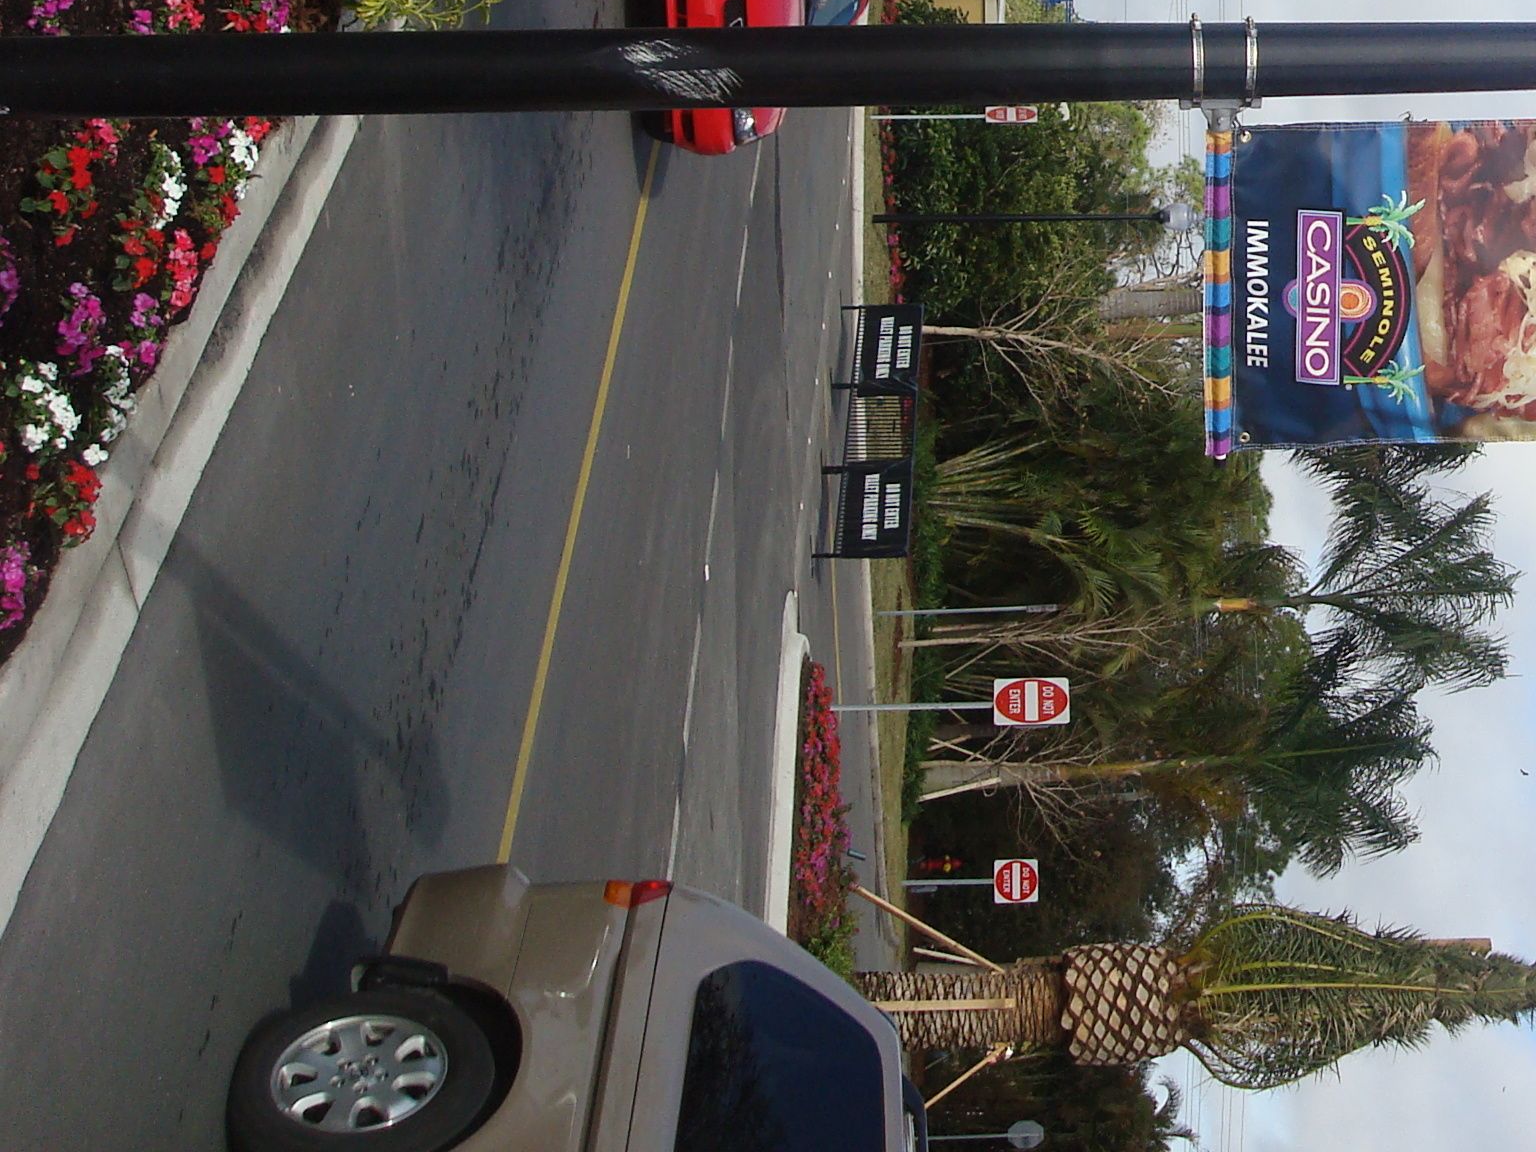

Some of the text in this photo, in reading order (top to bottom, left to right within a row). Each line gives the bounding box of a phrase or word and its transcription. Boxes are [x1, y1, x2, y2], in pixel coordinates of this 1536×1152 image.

[1246, 220, 1269, 367] IMMOKALEE
[1304, 220, 1332, 376] CASINO
[1359, 236, 1394, 364] SEMINOLE
[876, 317, 894, 379] VALET PARKING ONLY
[896, 326, 913, 368] DO NOT ENTER
[861, 474, 880, 540] VALET PARKING ONLY
[884, 483, 900, 529] DO NOT ENTER
[1009, 689, 1020, 714] ENTER
[1042, 686, 1054, 714] DO NOT
[1022, 867, 1030, 894] DO NOT
